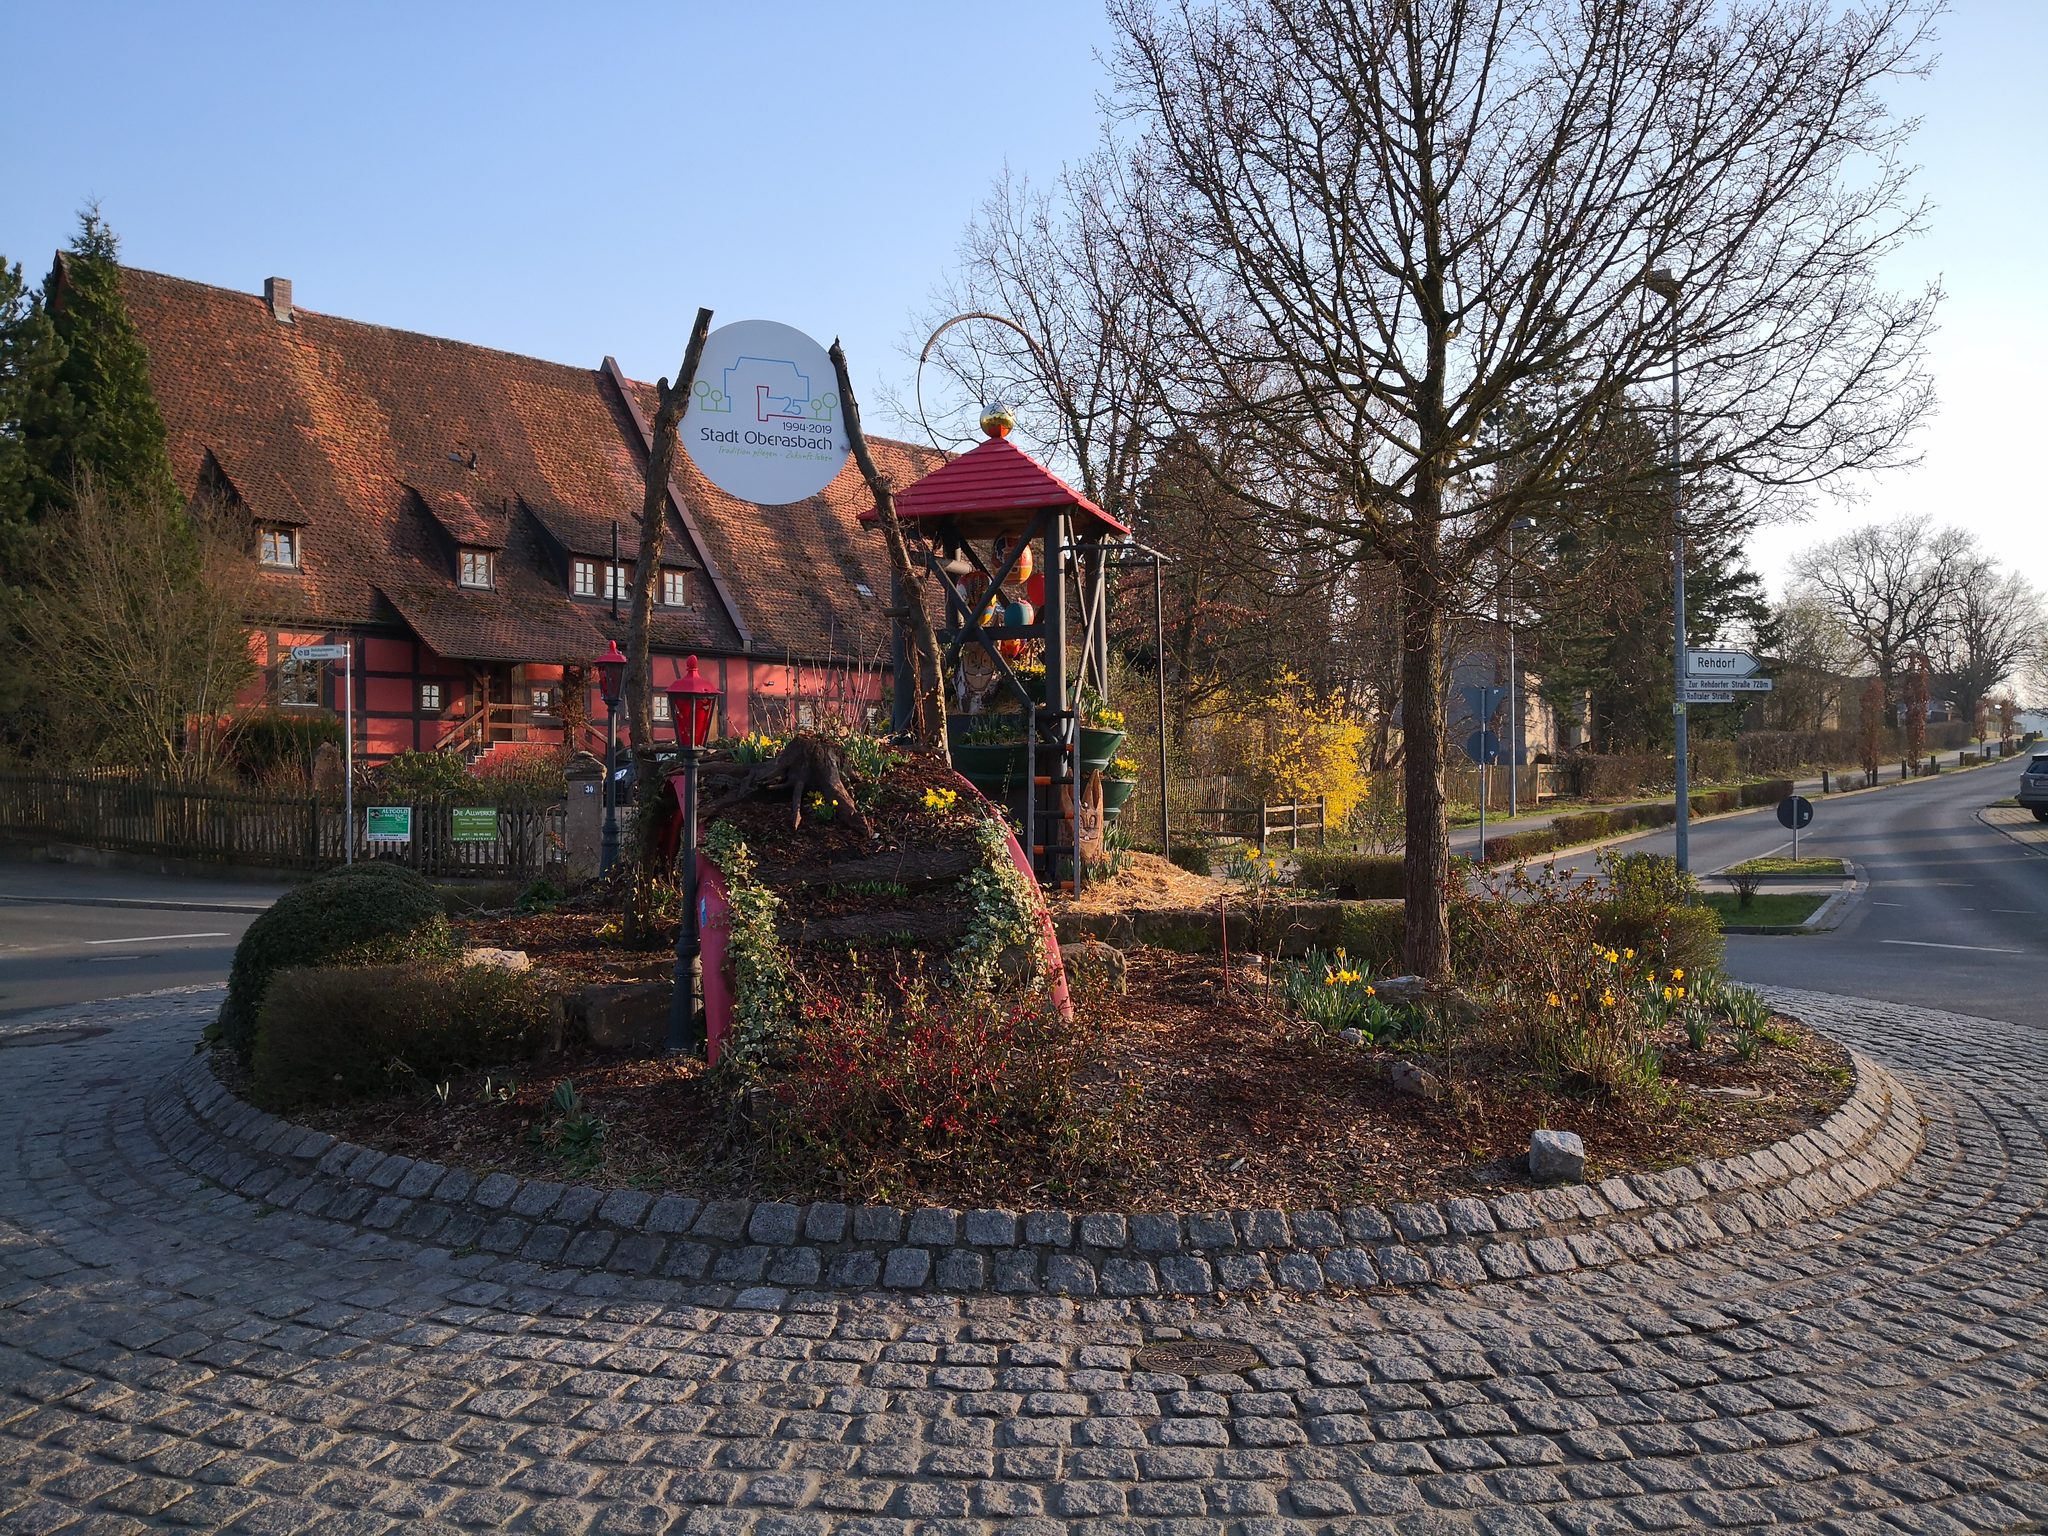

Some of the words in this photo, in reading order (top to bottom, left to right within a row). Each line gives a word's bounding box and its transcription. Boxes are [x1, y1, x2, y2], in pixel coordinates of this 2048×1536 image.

[783, 397, 801, 415] 25
[701, 427, 739, 443] Stadt
[745, 431, 832, 450] Oberasbach
[718, 445, 751, 456] Tradition
[752, 449, 778, 460] pflegen
[785, 450, 812, 461] Zukunft
[814, 453, 833, 462] leben
[1698, 657, 1735, 668] Rehdorf
[1688, 680, 1699, 689] Zur
[1701, 680, 1729, 689] Rehdorfer
[1731, 680, 1751, 689] Straße
[1711, 692, 1730, 701] Straße
[585, 785, 593, 793] 30
